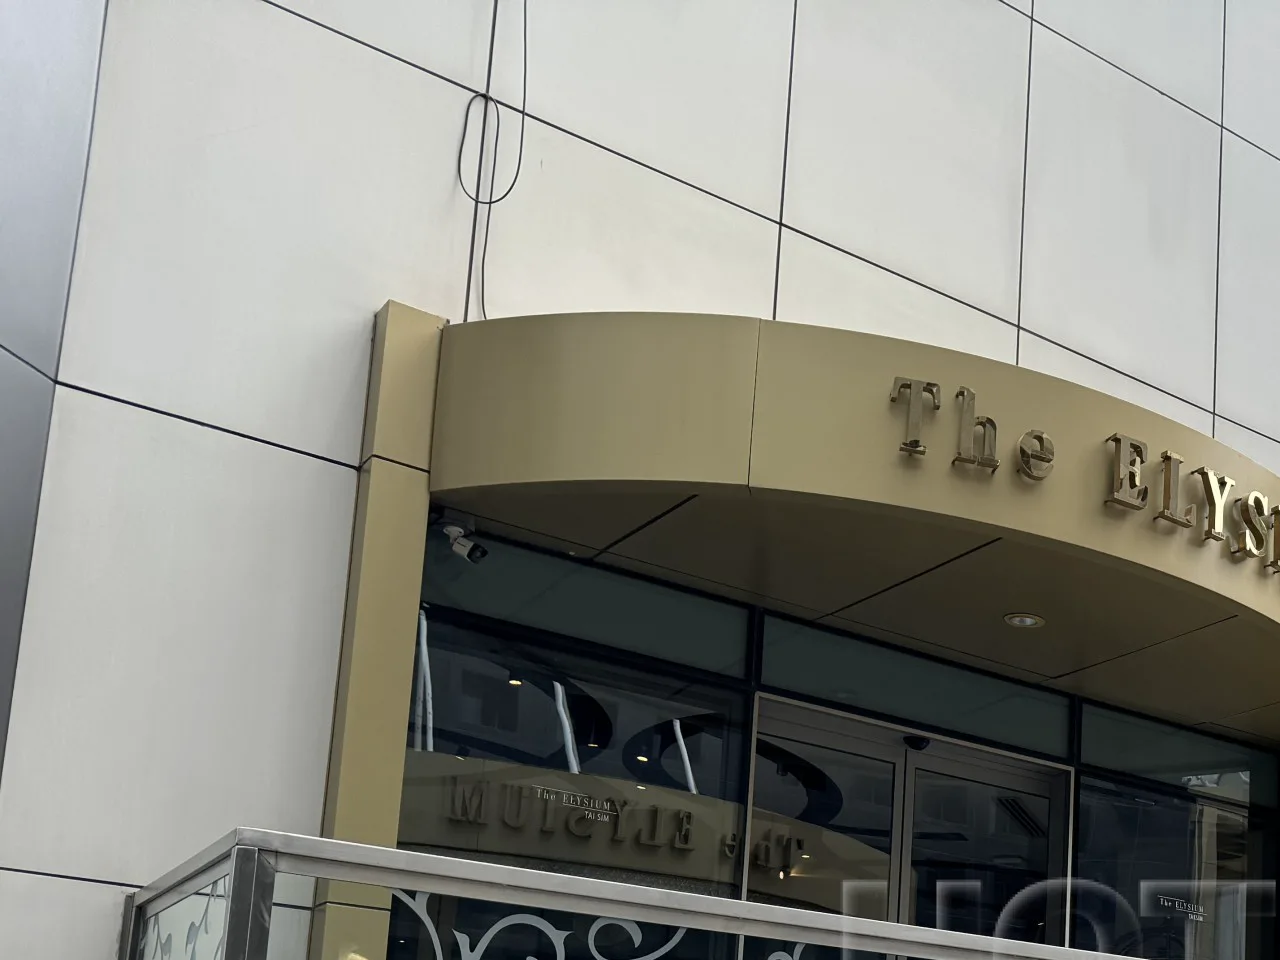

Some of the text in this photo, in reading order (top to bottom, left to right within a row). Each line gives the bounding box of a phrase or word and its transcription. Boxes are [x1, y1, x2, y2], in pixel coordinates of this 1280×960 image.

[889, 376, 1055, 482] The
[536, 788, 610, 811] The ELYSIUM
[1175, 901, 1204, 912] ELYSIUM
